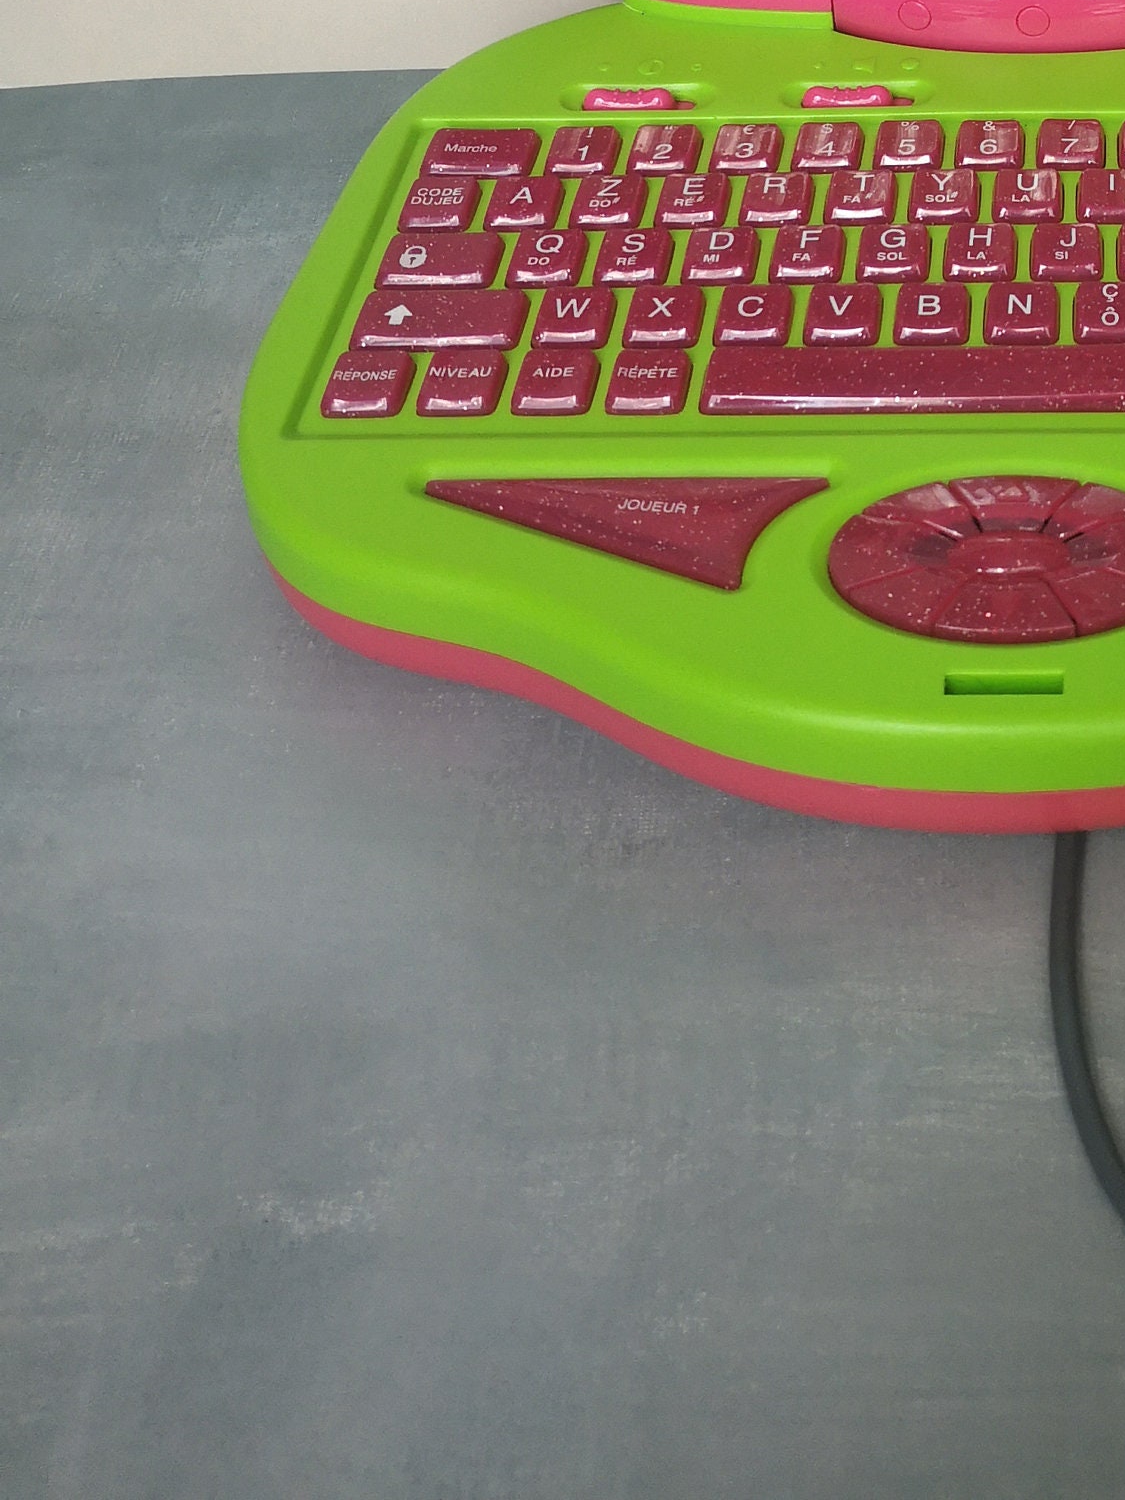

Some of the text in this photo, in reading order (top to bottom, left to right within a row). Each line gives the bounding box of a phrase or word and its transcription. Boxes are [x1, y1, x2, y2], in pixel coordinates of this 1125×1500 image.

[444, 144, 497, 153] Marche
[682, 178, 706, 195] E
[853, 174, 875, 191] T
[410, 196, 463, 205] DU JEU
[418, 188, 465, 197] CODE
[510, 187, 533, 204] A
[536, 235, 563, 253] Q
[709, 232, 734, 250] D
[800, 230, 822, 248] F
[880, 229, 906, 248] G
[968, 228, 992, 246] H
[917, 295, 941, 316] B
[1007, 294, 1032, 315] N
[332, 368, 398, 382] RÉPONSE
[429, 366, 492, 379] NIVEAU
[531, 366, 576, 378] AIDE
[616, 365, 679, 379] RÉPÈTE
[617, 499, 700, 515] JOUEUR 1
